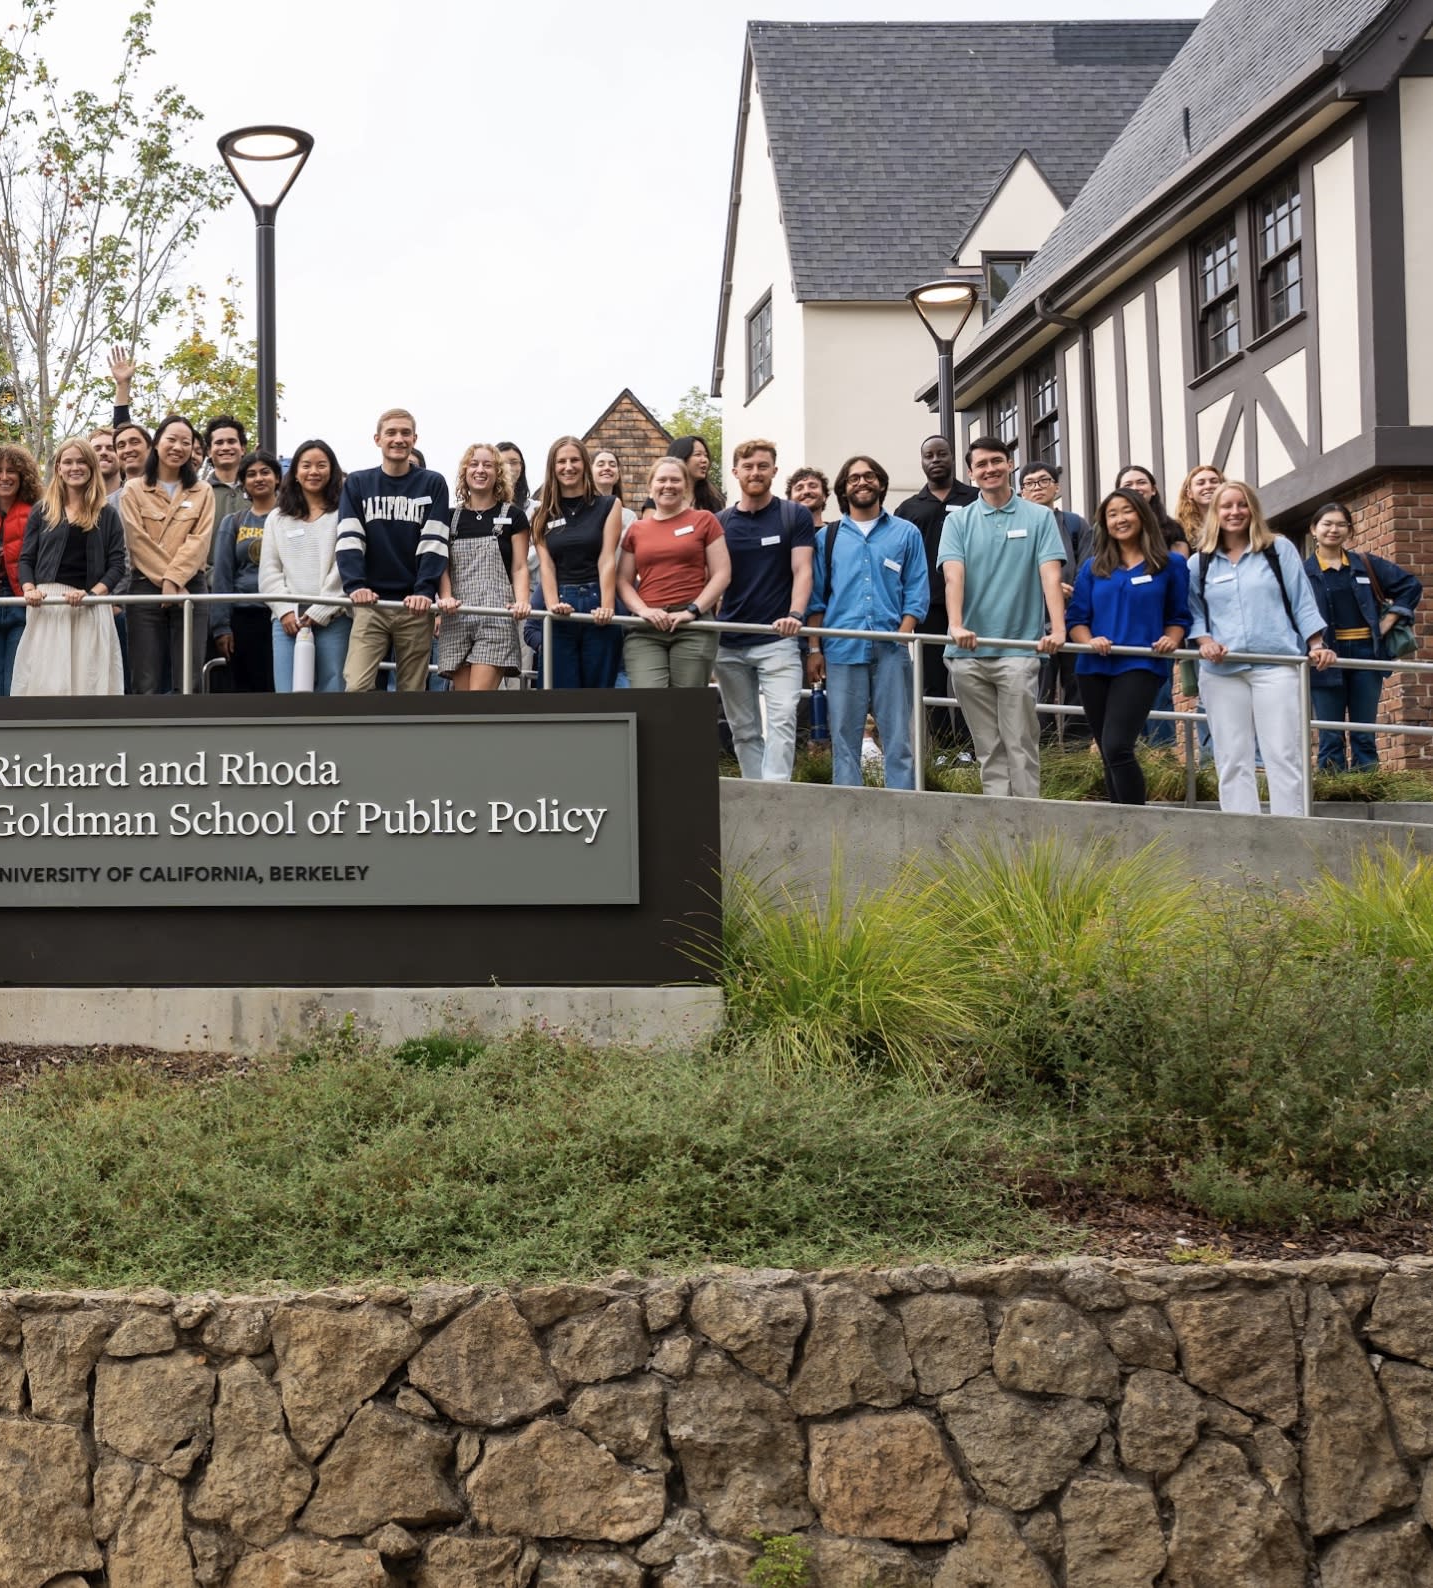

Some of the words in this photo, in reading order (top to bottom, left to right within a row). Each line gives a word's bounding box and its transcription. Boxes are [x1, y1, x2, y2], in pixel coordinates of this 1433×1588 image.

[361, 495, 425, 525] ALIFORNI
[138, 750, 209, 787] and
[217, 750, 341, 786] Rhoda
[169, 799, 296, 837] School
[307, 799, 351, 836] of
[356, 798, 478, 835] Public
[487, 797, 609, 845] Policy
[106, 866, 135, 883] OF
[139, 865, 264, 885] CALIFORNIA,
[269, 865, 370, 883] BERKELEY
